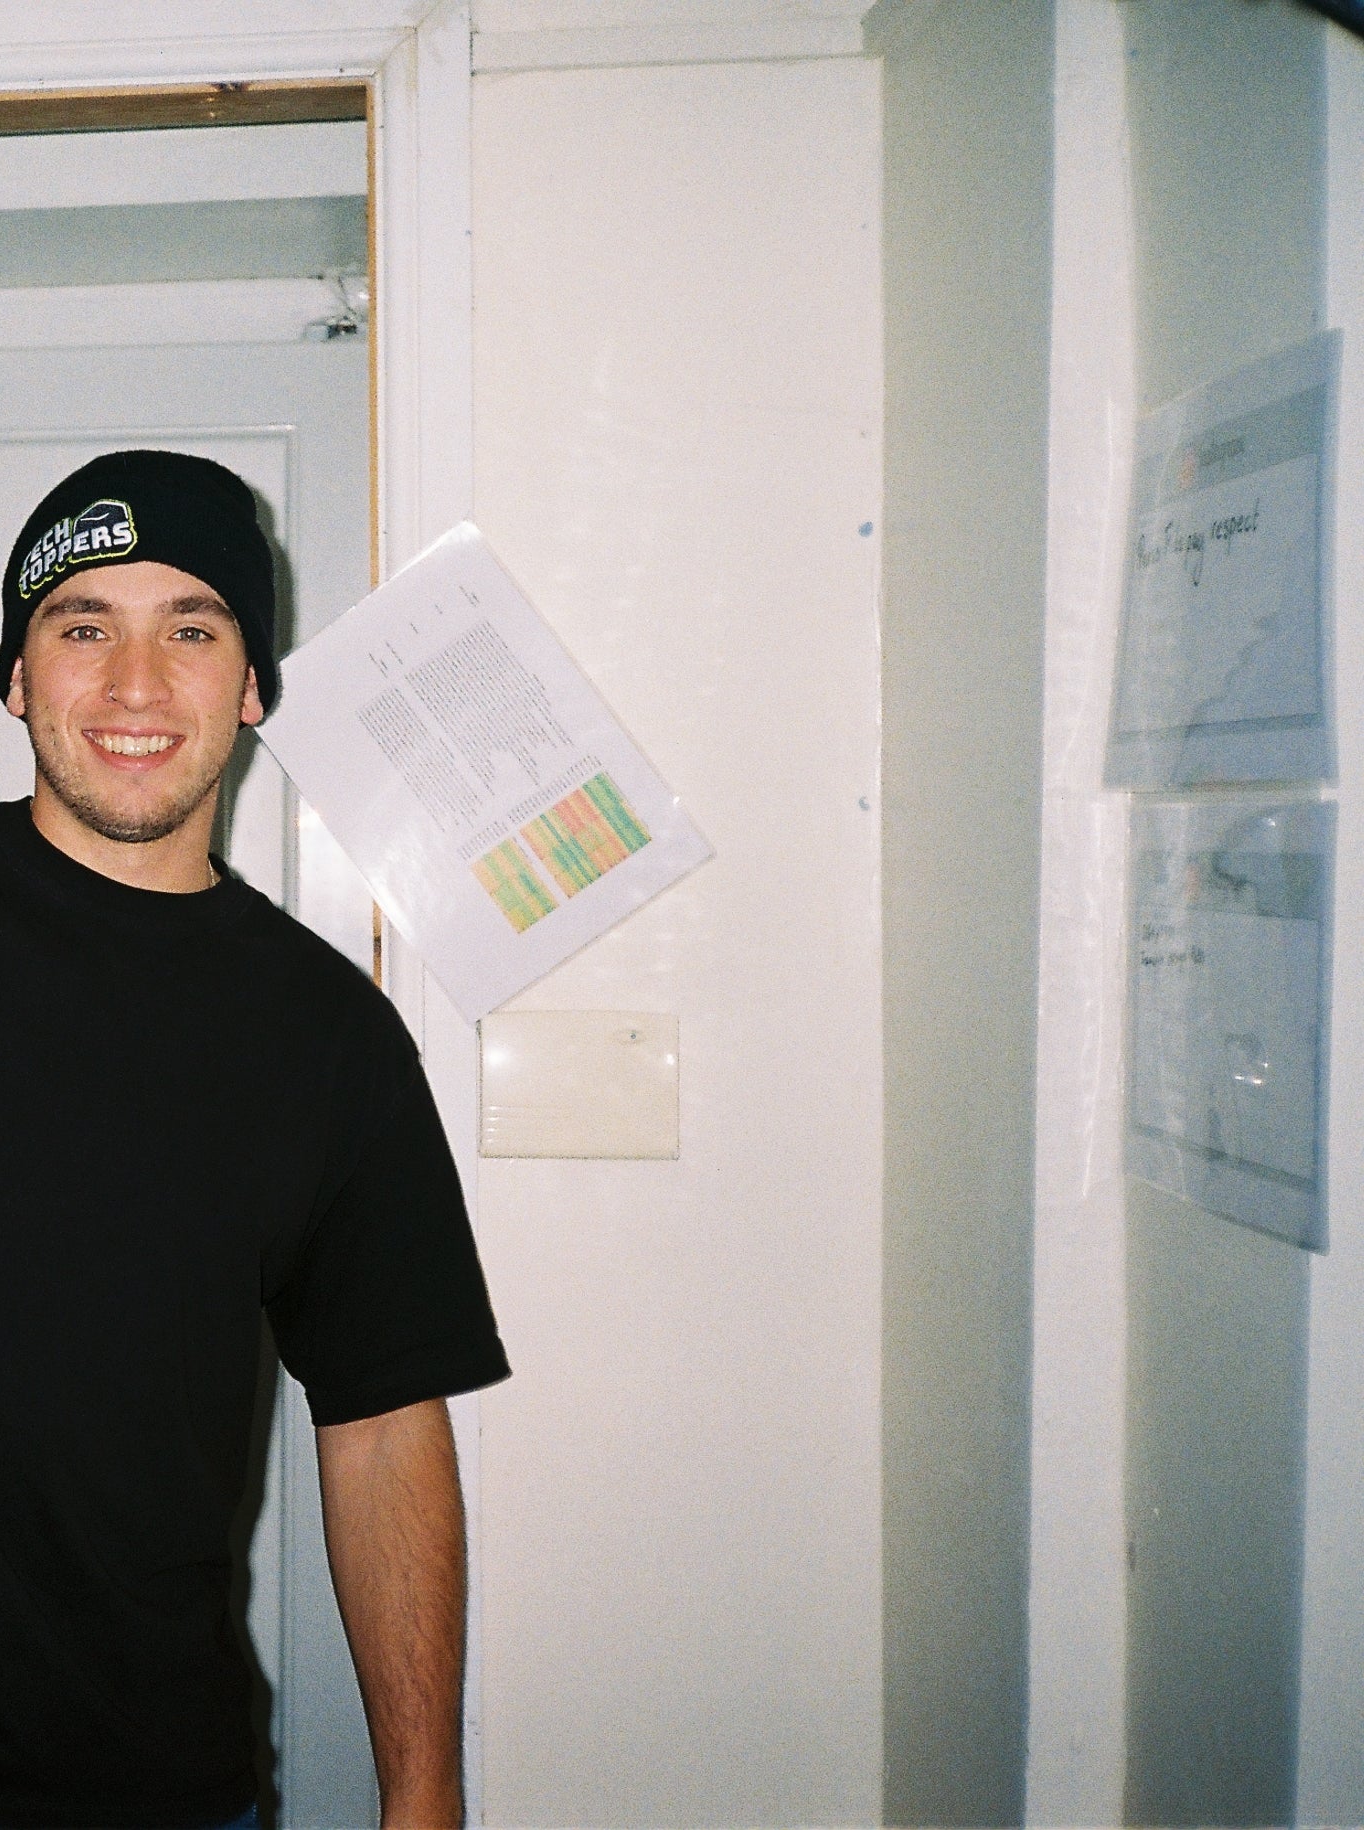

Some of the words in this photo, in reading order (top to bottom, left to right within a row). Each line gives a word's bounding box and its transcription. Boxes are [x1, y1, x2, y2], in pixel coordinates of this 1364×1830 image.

[19, 520, 132, 591] TOPPERS
[22, 517, 71, 571] TECH
[1210, 498, 1261, 557] respect
